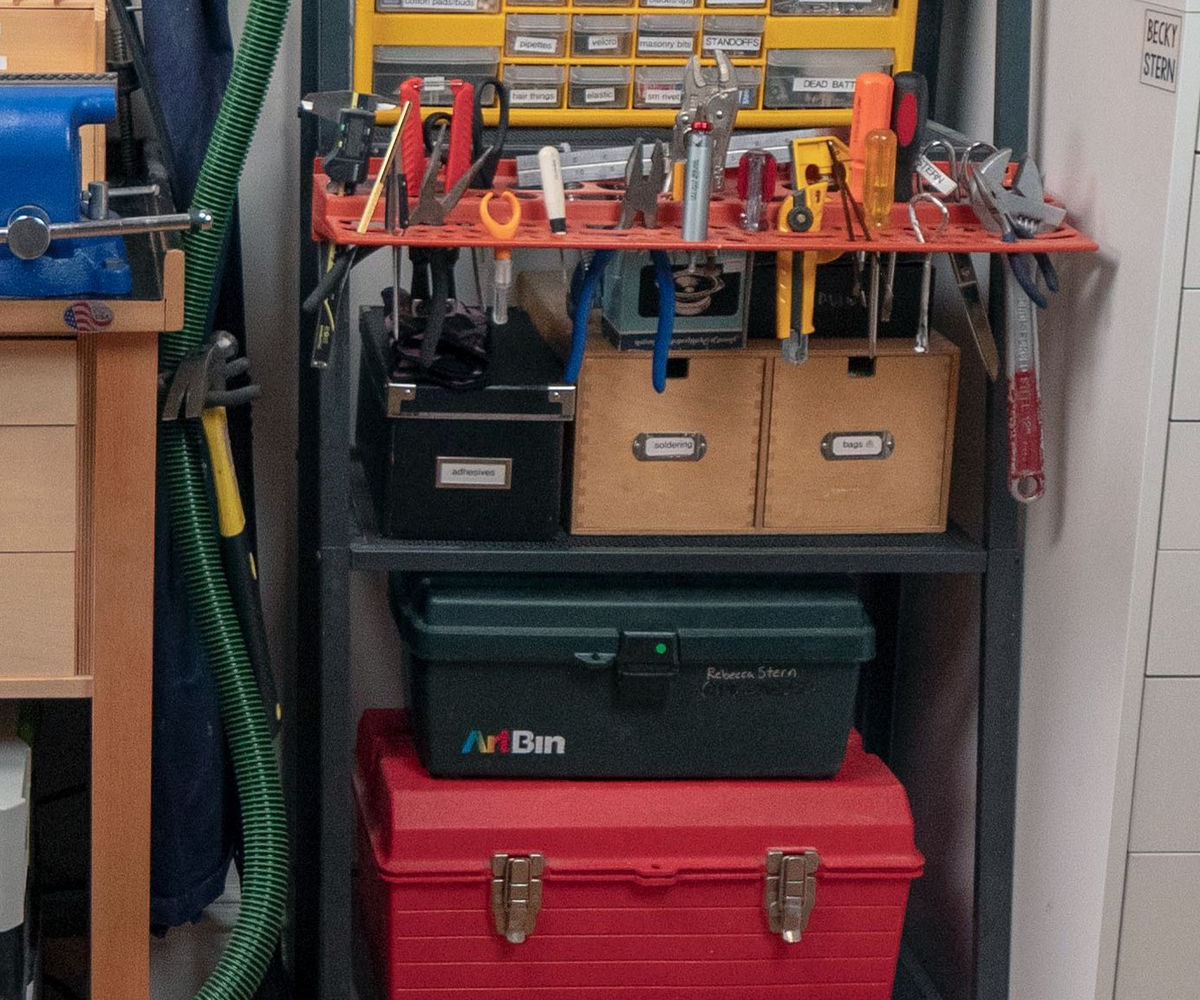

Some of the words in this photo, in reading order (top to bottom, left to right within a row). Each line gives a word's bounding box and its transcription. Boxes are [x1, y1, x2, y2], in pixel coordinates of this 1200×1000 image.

[1146, 18, 1179, 49] BECKY
[519, 39, 553, 51] pipettes
[591, 37, 617, 47] velcro
[639, 40, 675, 50] masonry
[677, 39, 692, 50] bits
[706, 36, 760, 47] STANDOFFS
[1143, 51, 1177, 84] STERN
[803, 79, 828, 89] DEAD
[831, 79, 856, 89] BATT
[512, 91, 528, 100] hair
[529, 91, 556, 102] things
[586, 90, 613, 100] elastic
[917, 158, 945, 185] STERN
[654, 439, 694, 452] soldering
[842, 439, 864, 452] bags
[451, 466, 496, 478] adhesives
[705, 665, 756, 681] Rebecca
[757, 664, 799, 680] Stern
[460, 728, 566, 755] ArtBin
